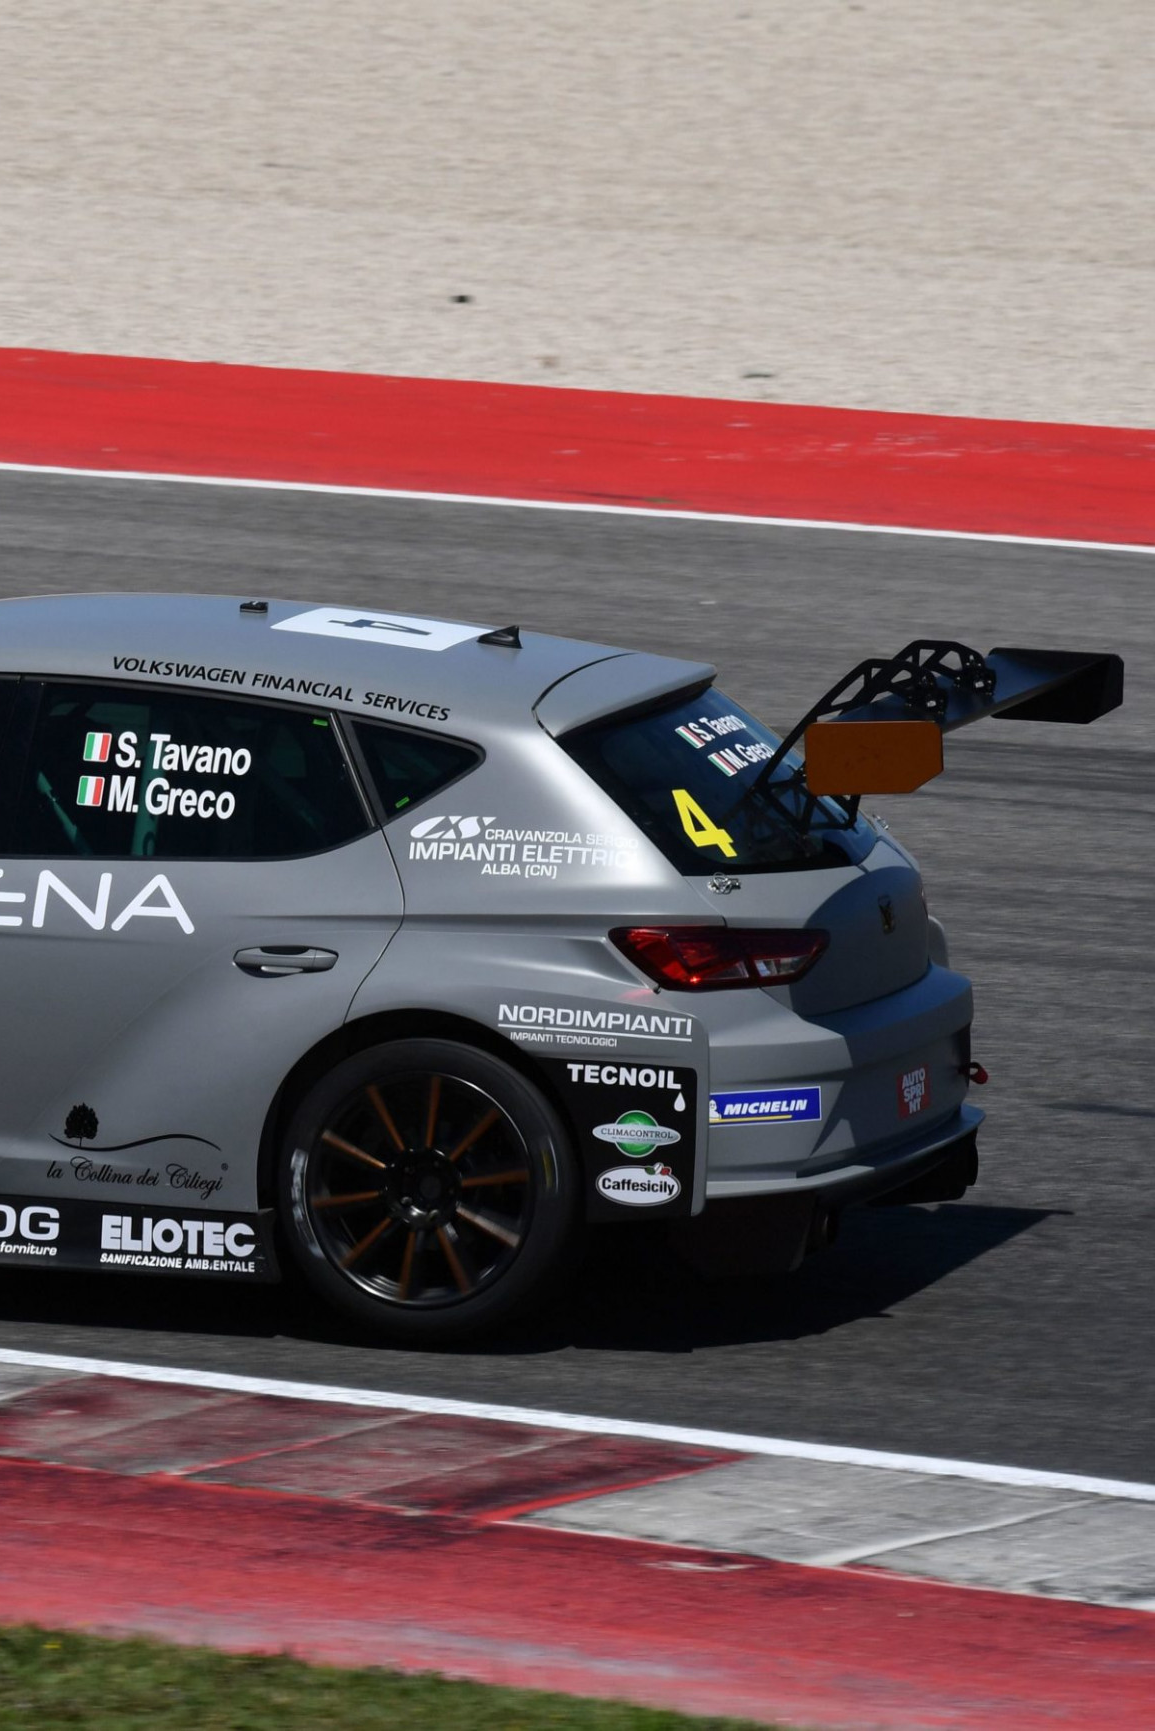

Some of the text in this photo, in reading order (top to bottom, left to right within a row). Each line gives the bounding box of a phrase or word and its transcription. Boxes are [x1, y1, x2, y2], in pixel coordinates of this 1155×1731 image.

[112, 656, 451, 722] VOLKSWAGEN FINANCIAL SERVICES
[688, 715, 747, 741] S. Tavano
[114, 731, 252, 776] S. Tavano
[719, 748, 749, 770] M.
[107, 775, 236, 820] M. Greco
[672, 789, 737, 858] 4
[484, 829, 582, 844] CRAVANZOLA
[409, 842, 638, 869] IMPIANTI ELETTRIC
[481, 864, 521, 876] ALBA
[498, 1004, 692, 1036] NORDIMPIANTI
[510, 1032, 617, 1048] IMPIANTI TECNOLOGICI
[566, 1063, 682, 1090] TECNOIL
[902, 1067, 926, 1090] AUTO
[903, 1081, 925, 1102] SPRI
[723, 1099, 808, 1116] MICHELIN
[600, 1127, 674, 1139] CLIMACONTROL
[47, 1160, 64, 1180] la
[70, 1156, 133, 1185] Collina
[136, 1168, 160, 1186] dei
[601, 1177, 675, 1196] Caffesicily
[100, 1214, 256, 1258] ELIOTEC
[100, 1252, 256, 1273] SANIFICAZIONE AMBENTALE
